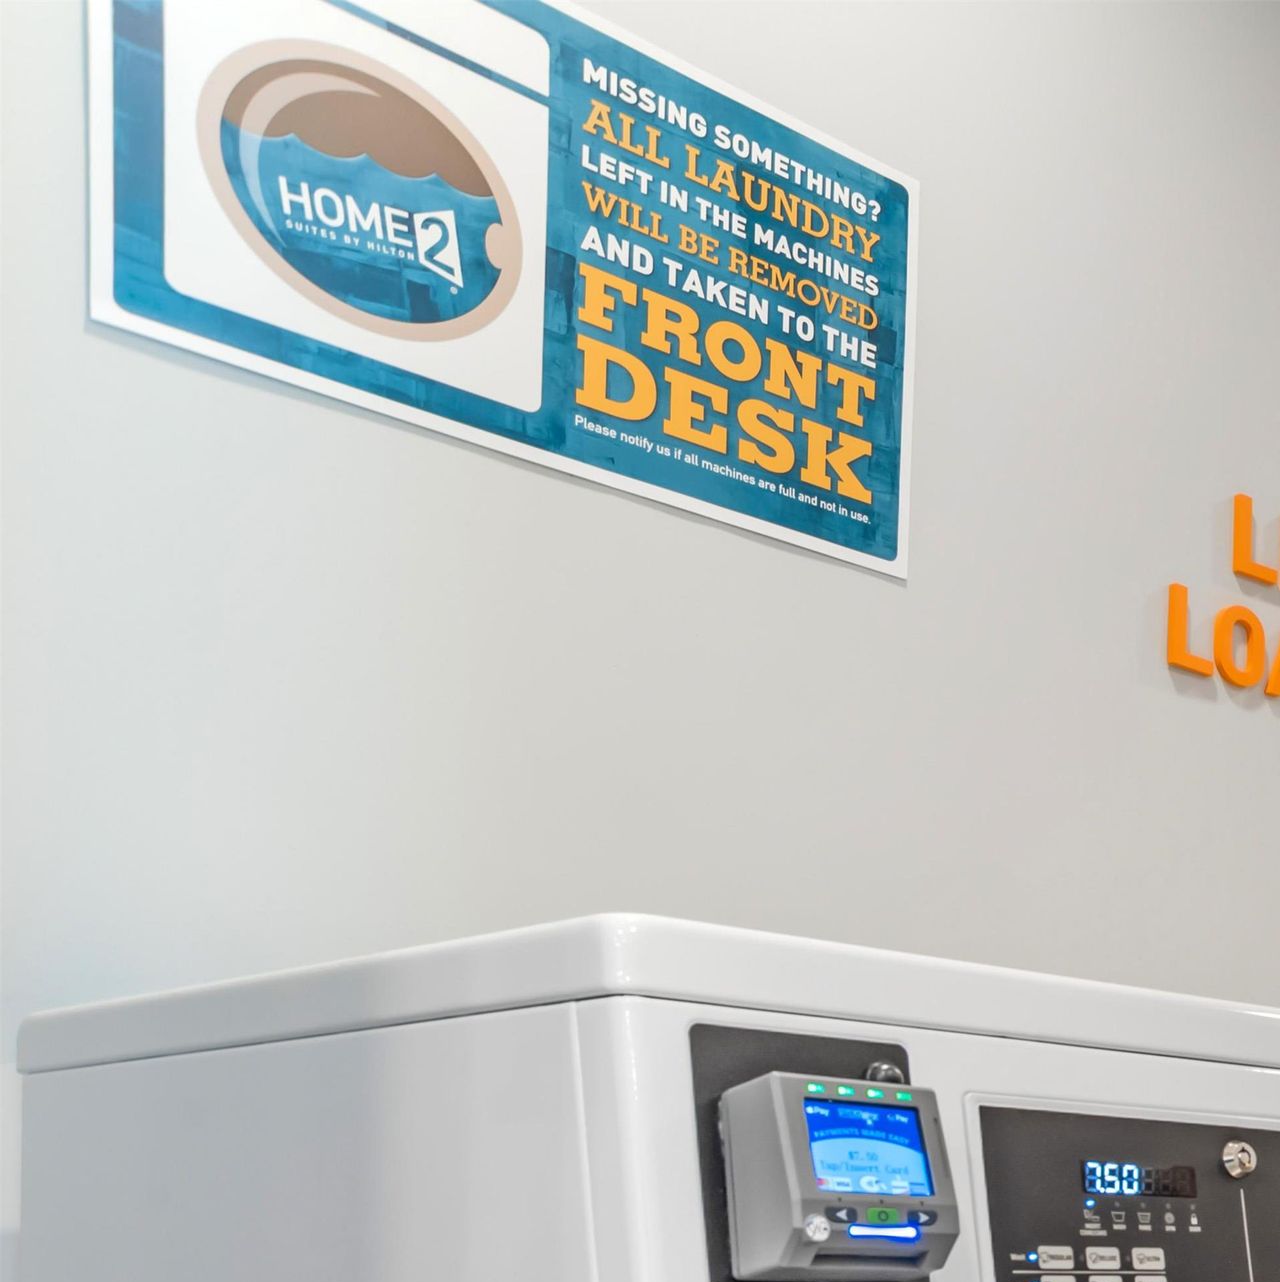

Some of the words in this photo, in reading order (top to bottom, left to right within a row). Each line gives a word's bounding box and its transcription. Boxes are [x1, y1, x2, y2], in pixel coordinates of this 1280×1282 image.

[582, 99, 670, 169] ALL
[684, 144, 880, 263] LAUNDRY
[583, 58, 707, 138] MISSING
[714, 125, 881, 222] SOMETHING?
[285, 219, 337, 241] SUITES
[344, 234, 360, 247] BY
[367, 241, 415, 261] HILTON
[582, 145, 653, 195] LEFT
[660, 181, 688, 213] IN
[696, 197, 747, 239] THE
[754, 224, 879, 296] MACHINES
[582, 181, 669, 243] WILL
[679, 224, 720, 265] BE
[728, 246, 879, 330] REMOVED
[578, 262, 876, 428] FRONT
[580, 226, 654, 276] AND
[663, 258, 769, 325] TAKEN
[777, 306, 815, 342] TO
[822, 325, 877, 368] THE
[575, 333, 872, 505] DESK
[575, 414, 617, 439] Please
[620, 428, 654, 453] notify
[656, 444, 671, 457] us
[674, 449, 681, 460] if
[684, 452, 699, 466] all
[701, 459, 755, 485] machines
[758, 477, 776, 492] are
[778, 483, 795, 498] full
[798, 491, 818, 507] and
[820, 496, 836, 513] not
[838, 502, 848, 517] in
[850, 510, 871, 525] use.
[1085, 1161, 1140, 1195] 7.50
